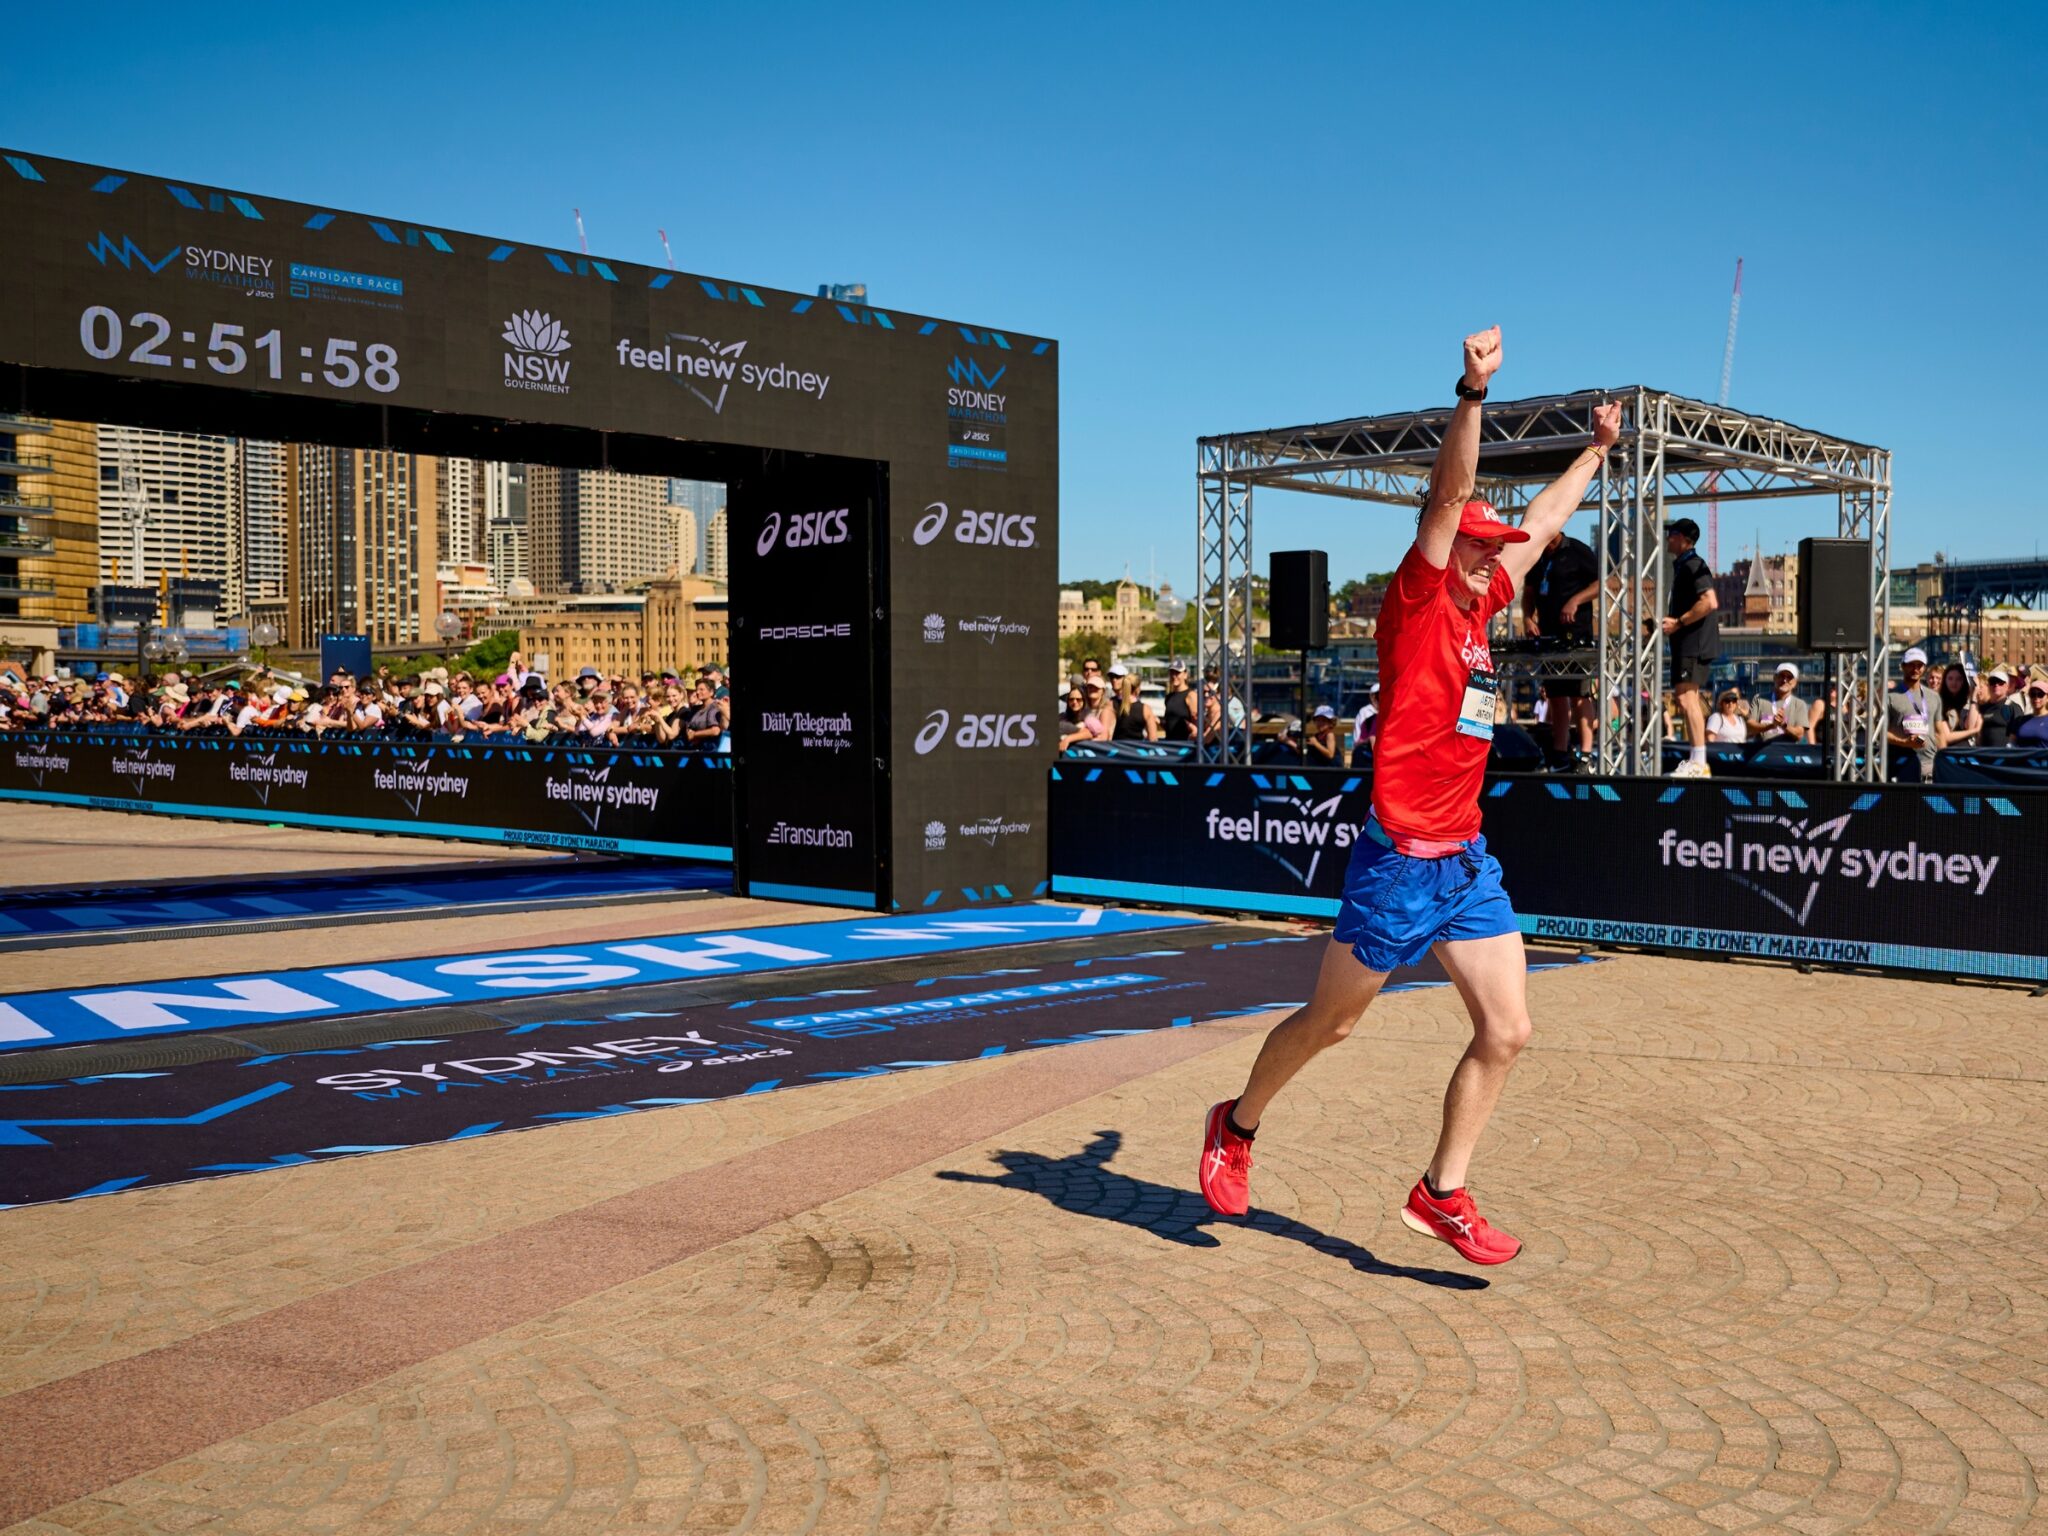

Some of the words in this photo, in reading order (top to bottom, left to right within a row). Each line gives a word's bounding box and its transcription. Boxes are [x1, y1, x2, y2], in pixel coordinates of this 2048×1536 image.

[186, 246, 273, 277] SYDNEY
[186, 268, 274, 290] MARATHON
[291, 267, 363, 286] CANDIDATE
[368, 279, 399, 291] RACE
[80, 305, 400, 392] 02:51:58
[504, 352, 570, 384] NSW
[616, 339, 671, 371] feel
[677, 354, 736, 380] new
[741, 362, 830, 400] sydney
[504, 378, 570, 394] GOVERNMENT
[948, 388, 1006, 412] SYDNEY
[948, 406, 1007, 424] MARATHON
[760, 623, 851, 640] PORSCHE
[924, 630, 945, 640] NSW
[959, 620, 977, 632] feel
[978, 623, 998, 632] new
[1000, 622, 1031, 636] sydney
[762, 712, 793, 735] Daily
[793, 712, 852, 736] Telegraph
[803, 737, 823, 747] We're
[823, 737, 833, 747] for
[834, 738, 852, 754] you
[15, 752, 29, 767] feel
[29, 755, 44, 767] new
[45, 755, 69, 773] sydney
[112, 757, 128, 774] feel
[128, 761, 146, 775] new
[146, 759, 175, 781] sydney
[230, 762, 249, 781] feel
[250, 767, 272, 783] new
[273, 765, 308, 788] sydney
[374, 768, 397, 790] feel
[398, 773, 425, 791] new
[426, 772, 468, 798] sydney
[546, 777, 572, 800] feel
[573, 782, 606, 802] new
[607, 781, 659, 811] sydney
[775, 822, 853, 848] Transurban
[960, 824, 978, 836] feel
[979, 825, 999, 835] new
[1000, 822, 1031, 835] sydney
[1206, 808, 1259, 842] feel
[1265, 818, 1330, 845] new
[504, 830, 524, 841] PROUD
[552, 834, 560, 844] OF
[561, 835, 584, 846] SYDNEY
[585, 838, 619, 849] MARATHON
[925, 837, 946, 848] NSW
[1658, 829, 1733, 870] feel
[1742, 841, 1834, 876] new
[1840, 841, 1999, 895] sydney
[1536, 918, 1588, 936] PROUD
[1591, 922, 1666, 945] SPONSOR
[1671, 929, 1692, 946] OF
[1696, 931, 1766, 951] SYDNEY
[1768, 938, 1871, 962] MARATHON
[772, 990, 1032, 1029] CANDIDATE
[1039, 975, 1145, 992] RACE
[316, 1031, 719, 1091] SYDNEY
[352, 1040, 770, 1101] MARATHON
